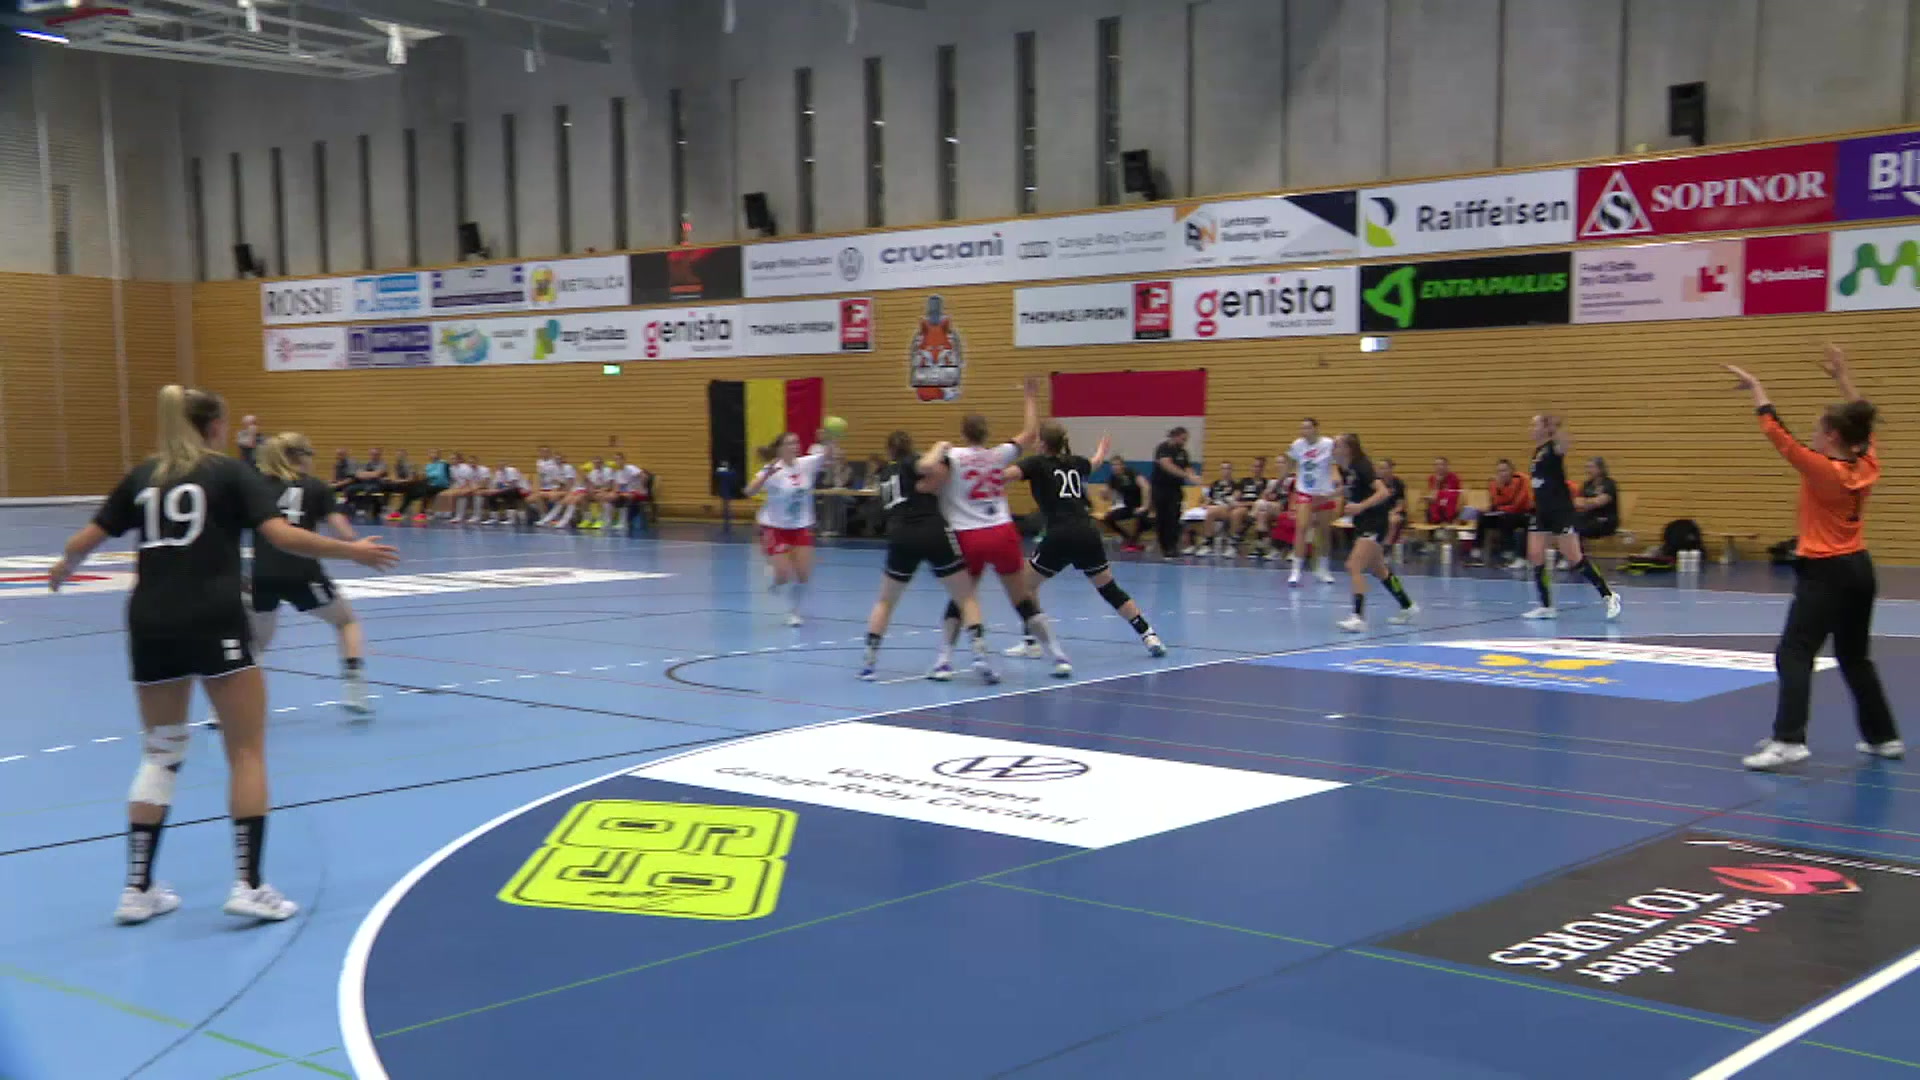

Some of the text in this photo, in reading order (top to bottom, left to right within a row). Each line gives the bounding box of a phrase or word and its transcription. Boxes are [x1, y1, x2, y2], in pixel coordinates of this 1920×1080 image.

[1650, 170, 1827, 213] SOPINOR
[1416, 197, 1569, 233] Raiffeisen
[879, 232, 1004, 265] cruciani
[1195, 276, 1335, 338] genista
[644, 311, 733, 358] genista
[1054, 468, 1081, 498] 20
[134, 483, 206, 549] 19
[714, 766, 829, 787] Garage
[925, 796, 1089, 827] Cruciani
[827, 766, 1044, 804] Volkswagen
[1488, 887, 1729, 971] TOITURES
